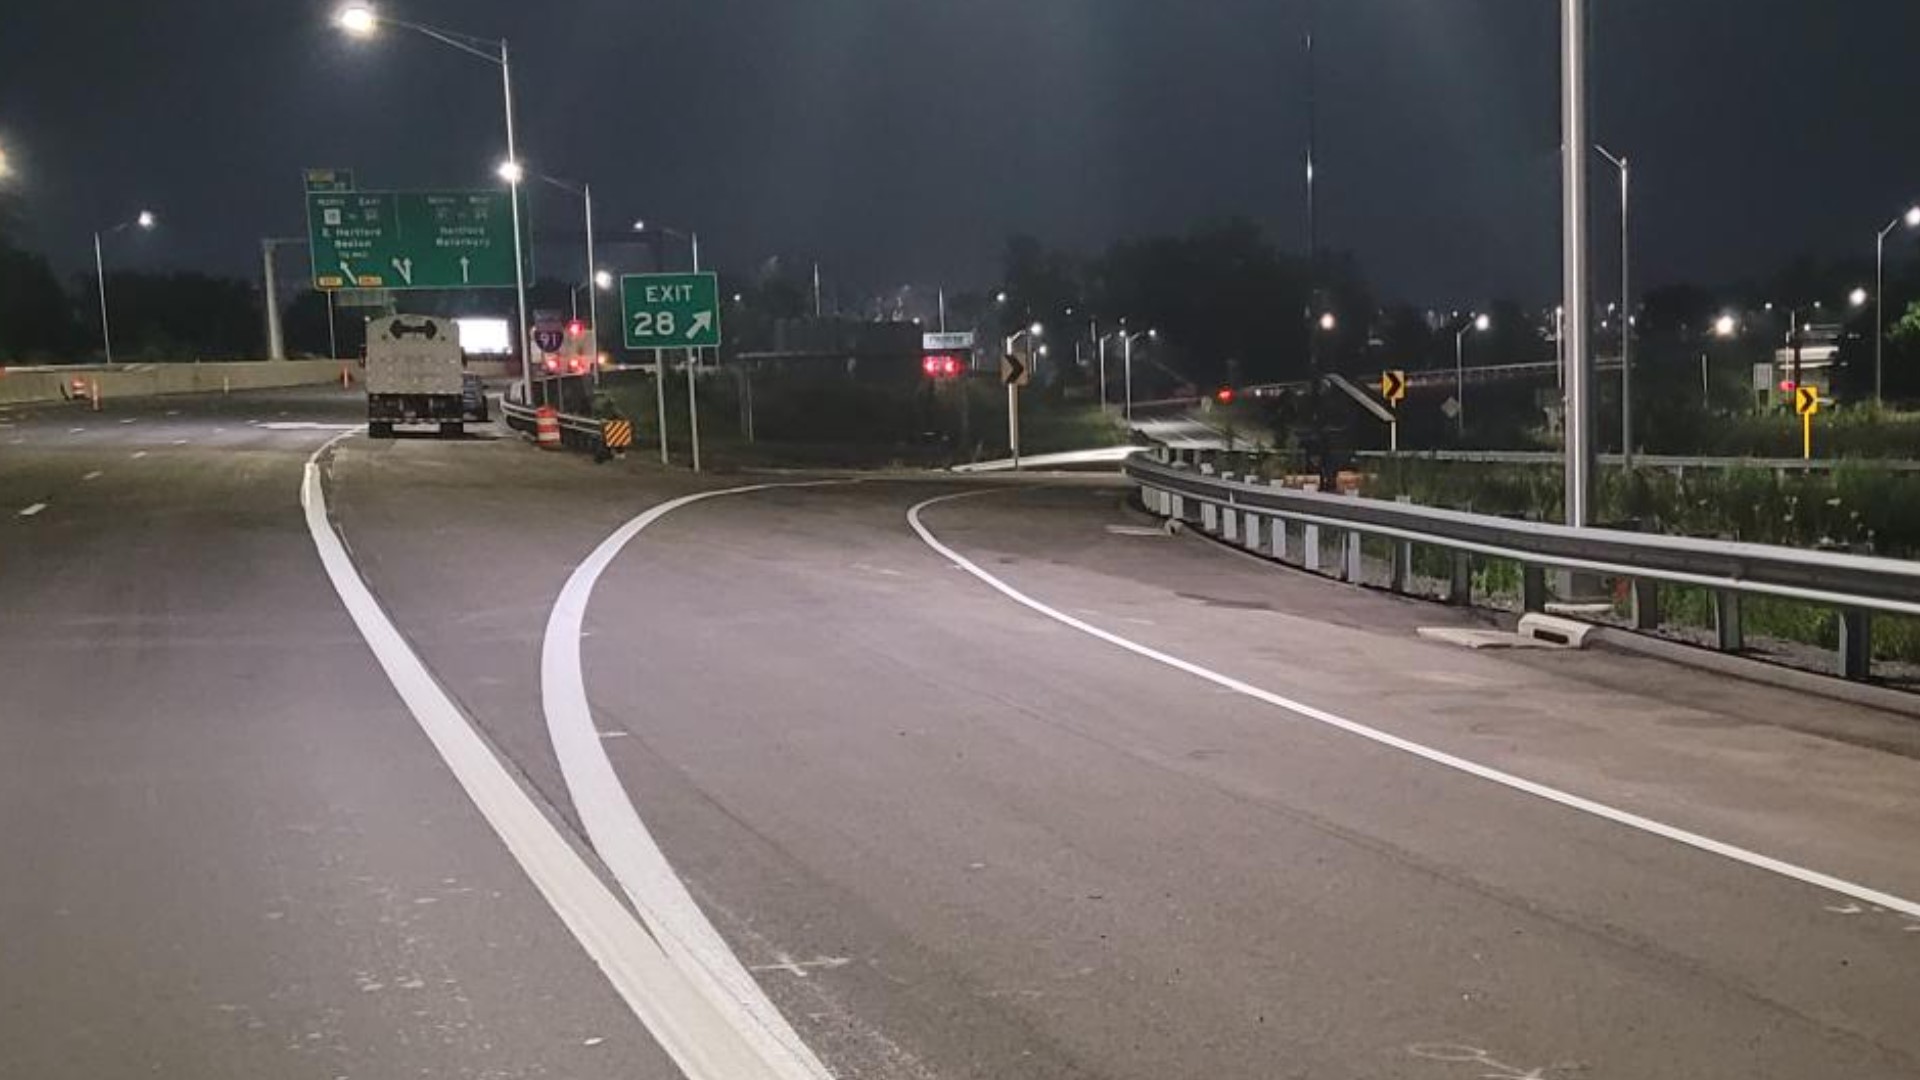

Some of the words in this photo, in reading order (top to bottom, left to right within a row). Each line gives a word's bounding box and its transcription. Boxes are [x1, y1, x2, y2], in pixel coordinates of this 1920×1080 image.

[645, 284, 693, 302] EXIT
[633, 311, 675, 336] 28
[540, 333, 557, 347] 91
